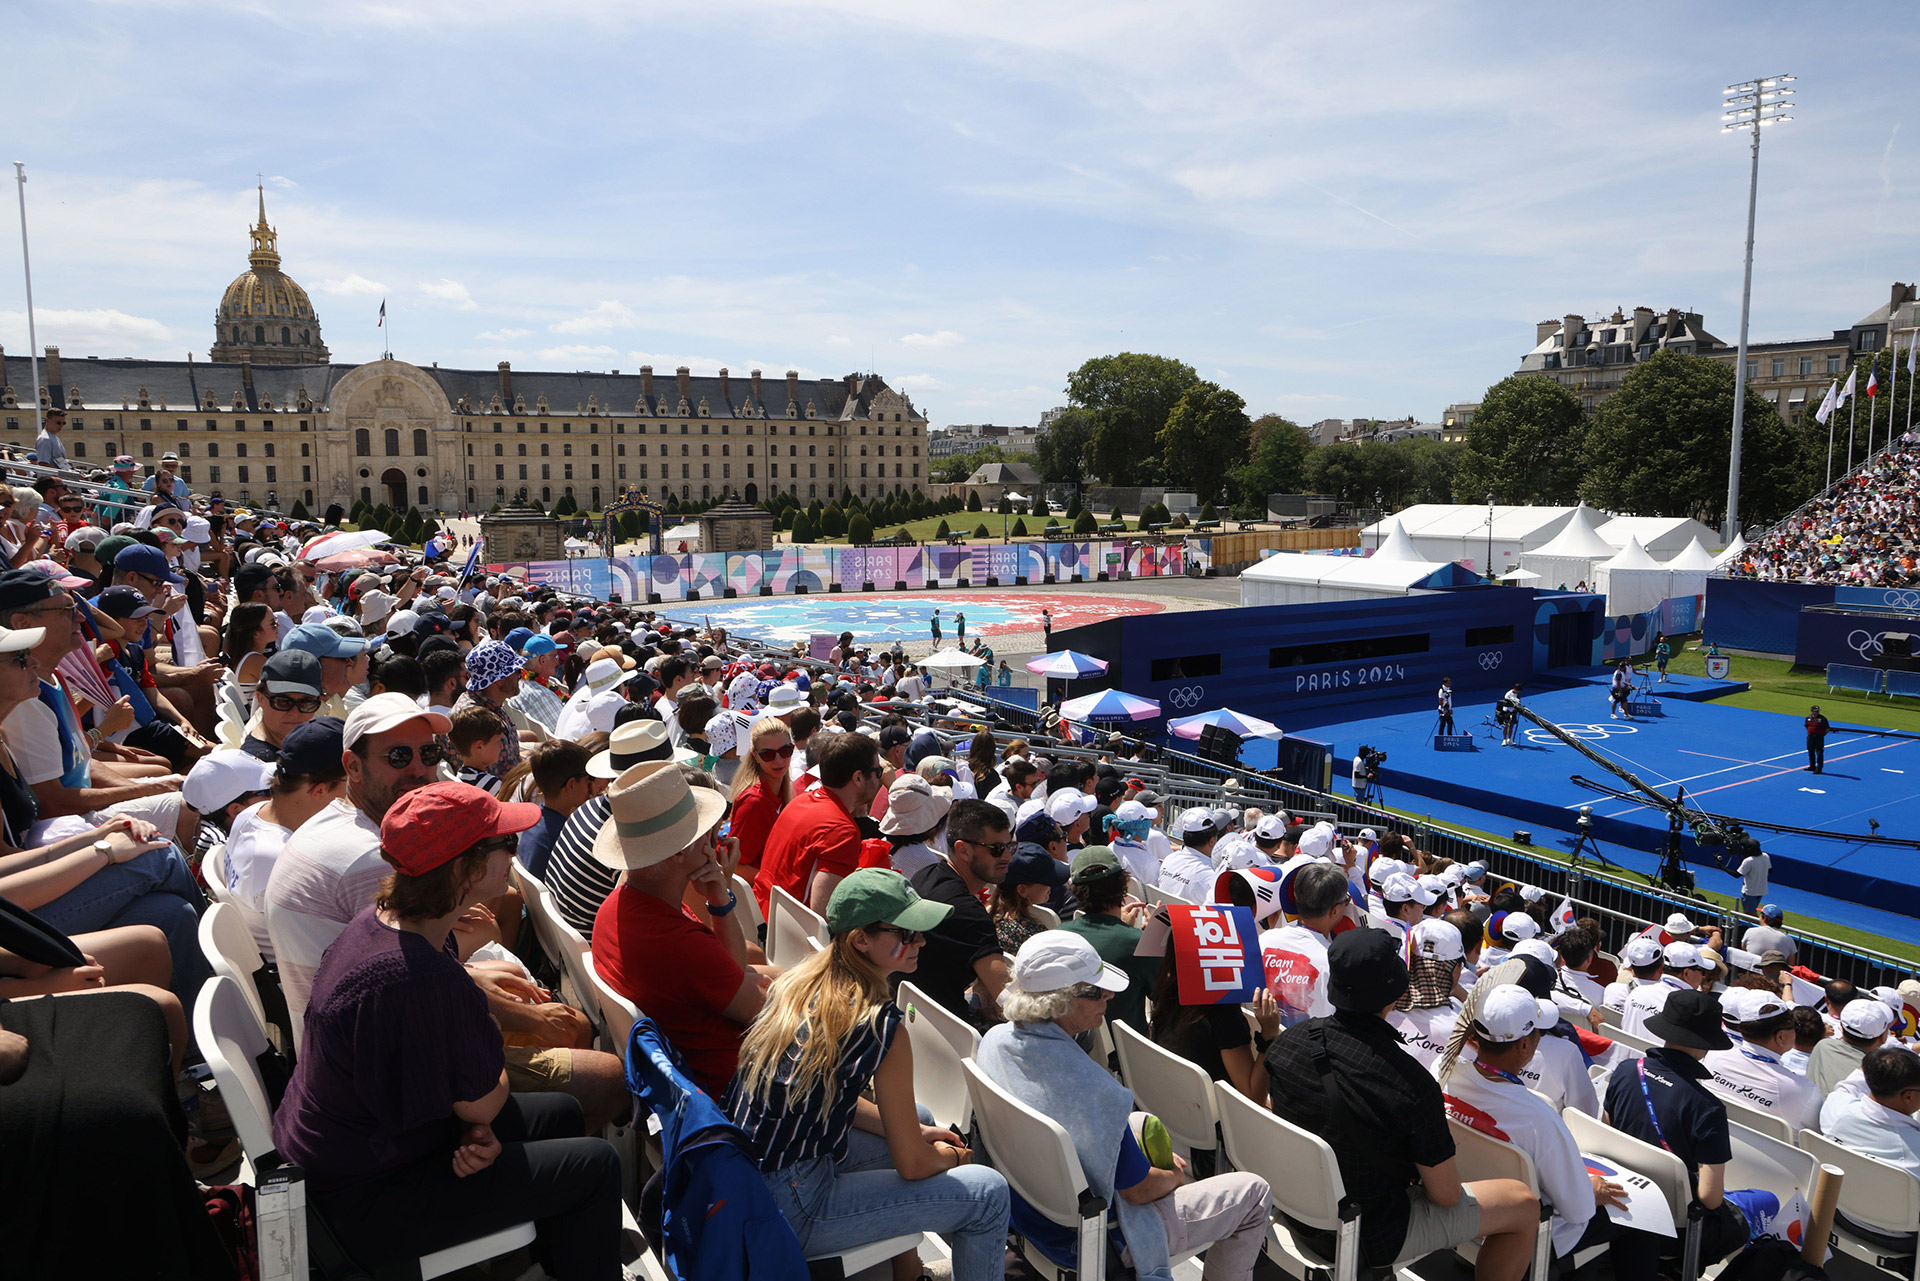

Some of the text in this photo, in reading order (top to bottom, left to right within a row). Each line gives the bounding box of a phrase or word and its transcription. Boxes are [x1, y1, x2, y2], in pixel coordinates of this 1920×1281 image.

[1358, 664, 1404, 685] 2024
[1264, 953, 1294, 969] Team
[1274, 968, 1310, 985] Korea
[1407, 1032, 1445, 1054] Kore
[1518, 1068, 1540, 1081] orea
[1713, 1070, 1773, 1108] Team Korea
